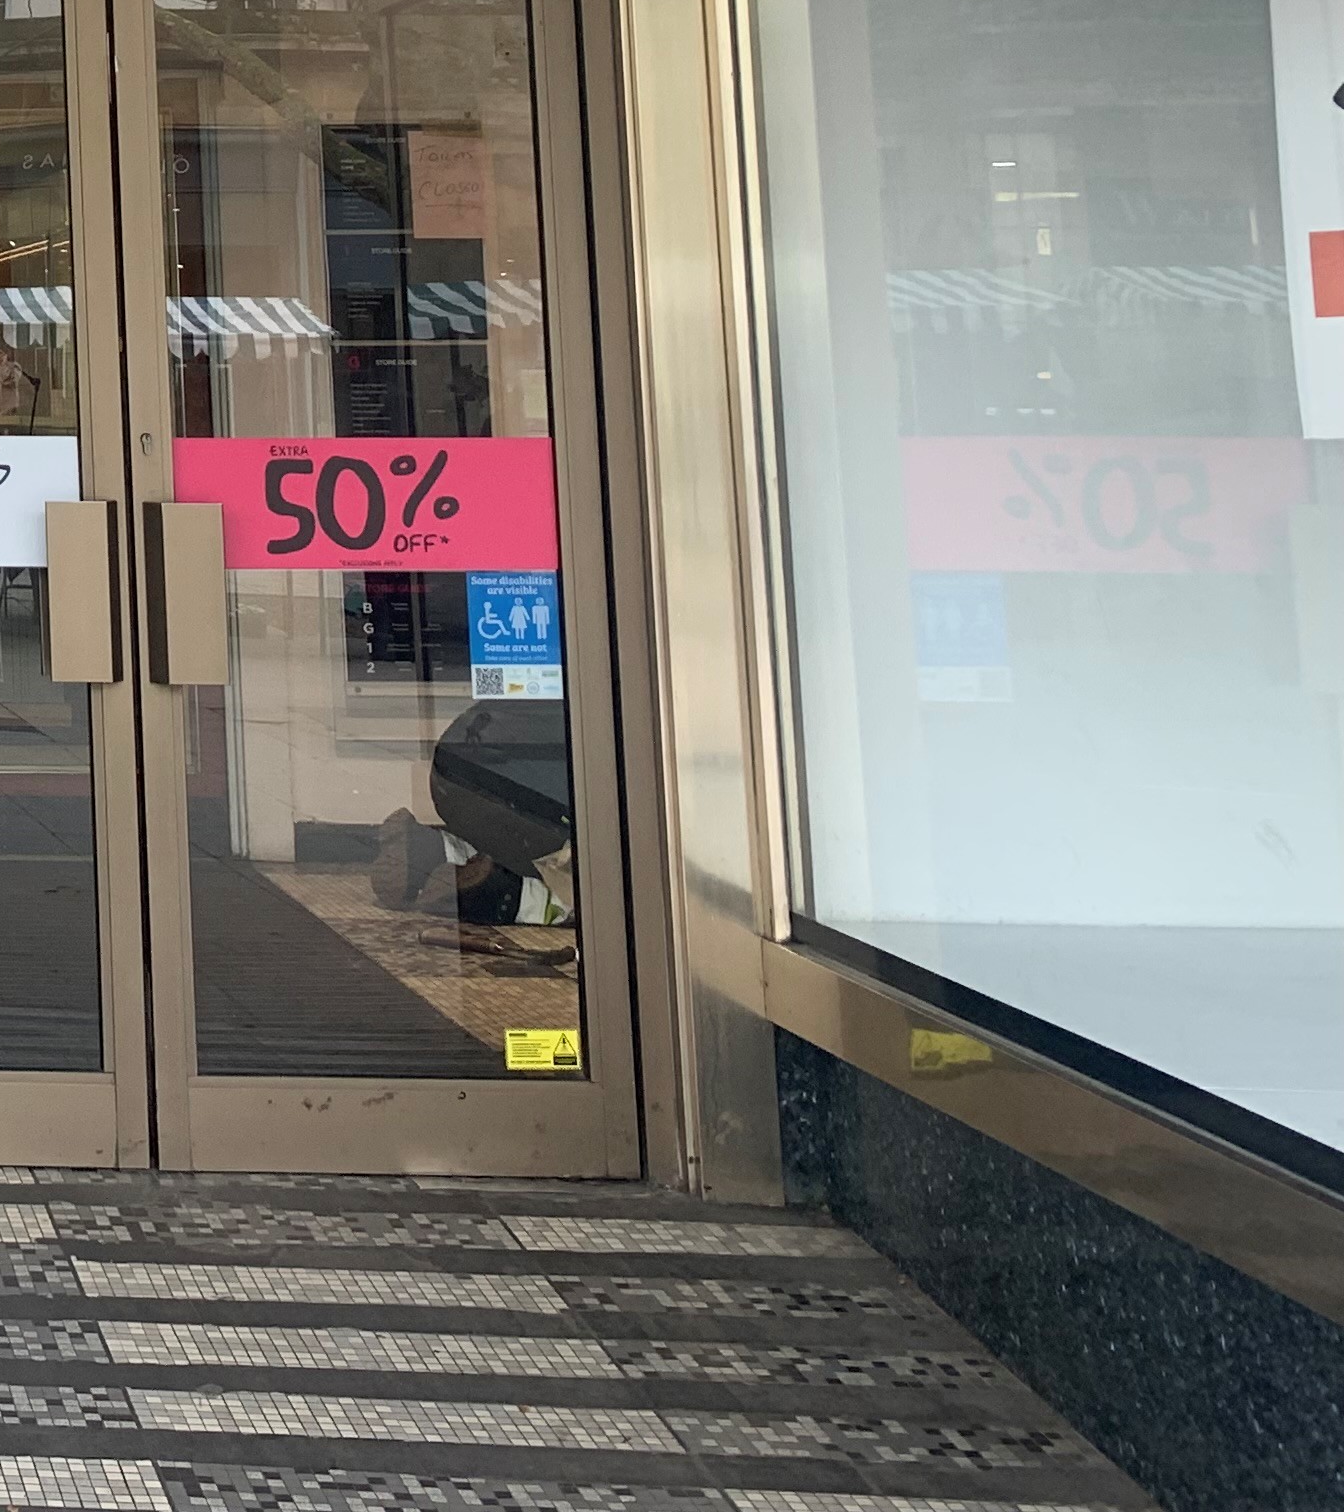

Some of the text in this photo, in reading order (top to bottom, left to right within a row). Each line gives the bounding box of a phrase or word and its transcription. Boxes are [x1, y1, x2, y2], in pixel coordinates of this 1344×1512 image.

[270, 445, 309, 457] EXTRA
[265, 450, 460, 555] 50%
[471, 576, 553, 585] Some disabilities
[487, 586, 538, 595] are visible
[363, 602, 373, 614] B
[363, 622, 374, 634] G
[484, 643, 510, 652] Some
[531, 643, 547, 652] not
[367, 662, 375, 673] 2
